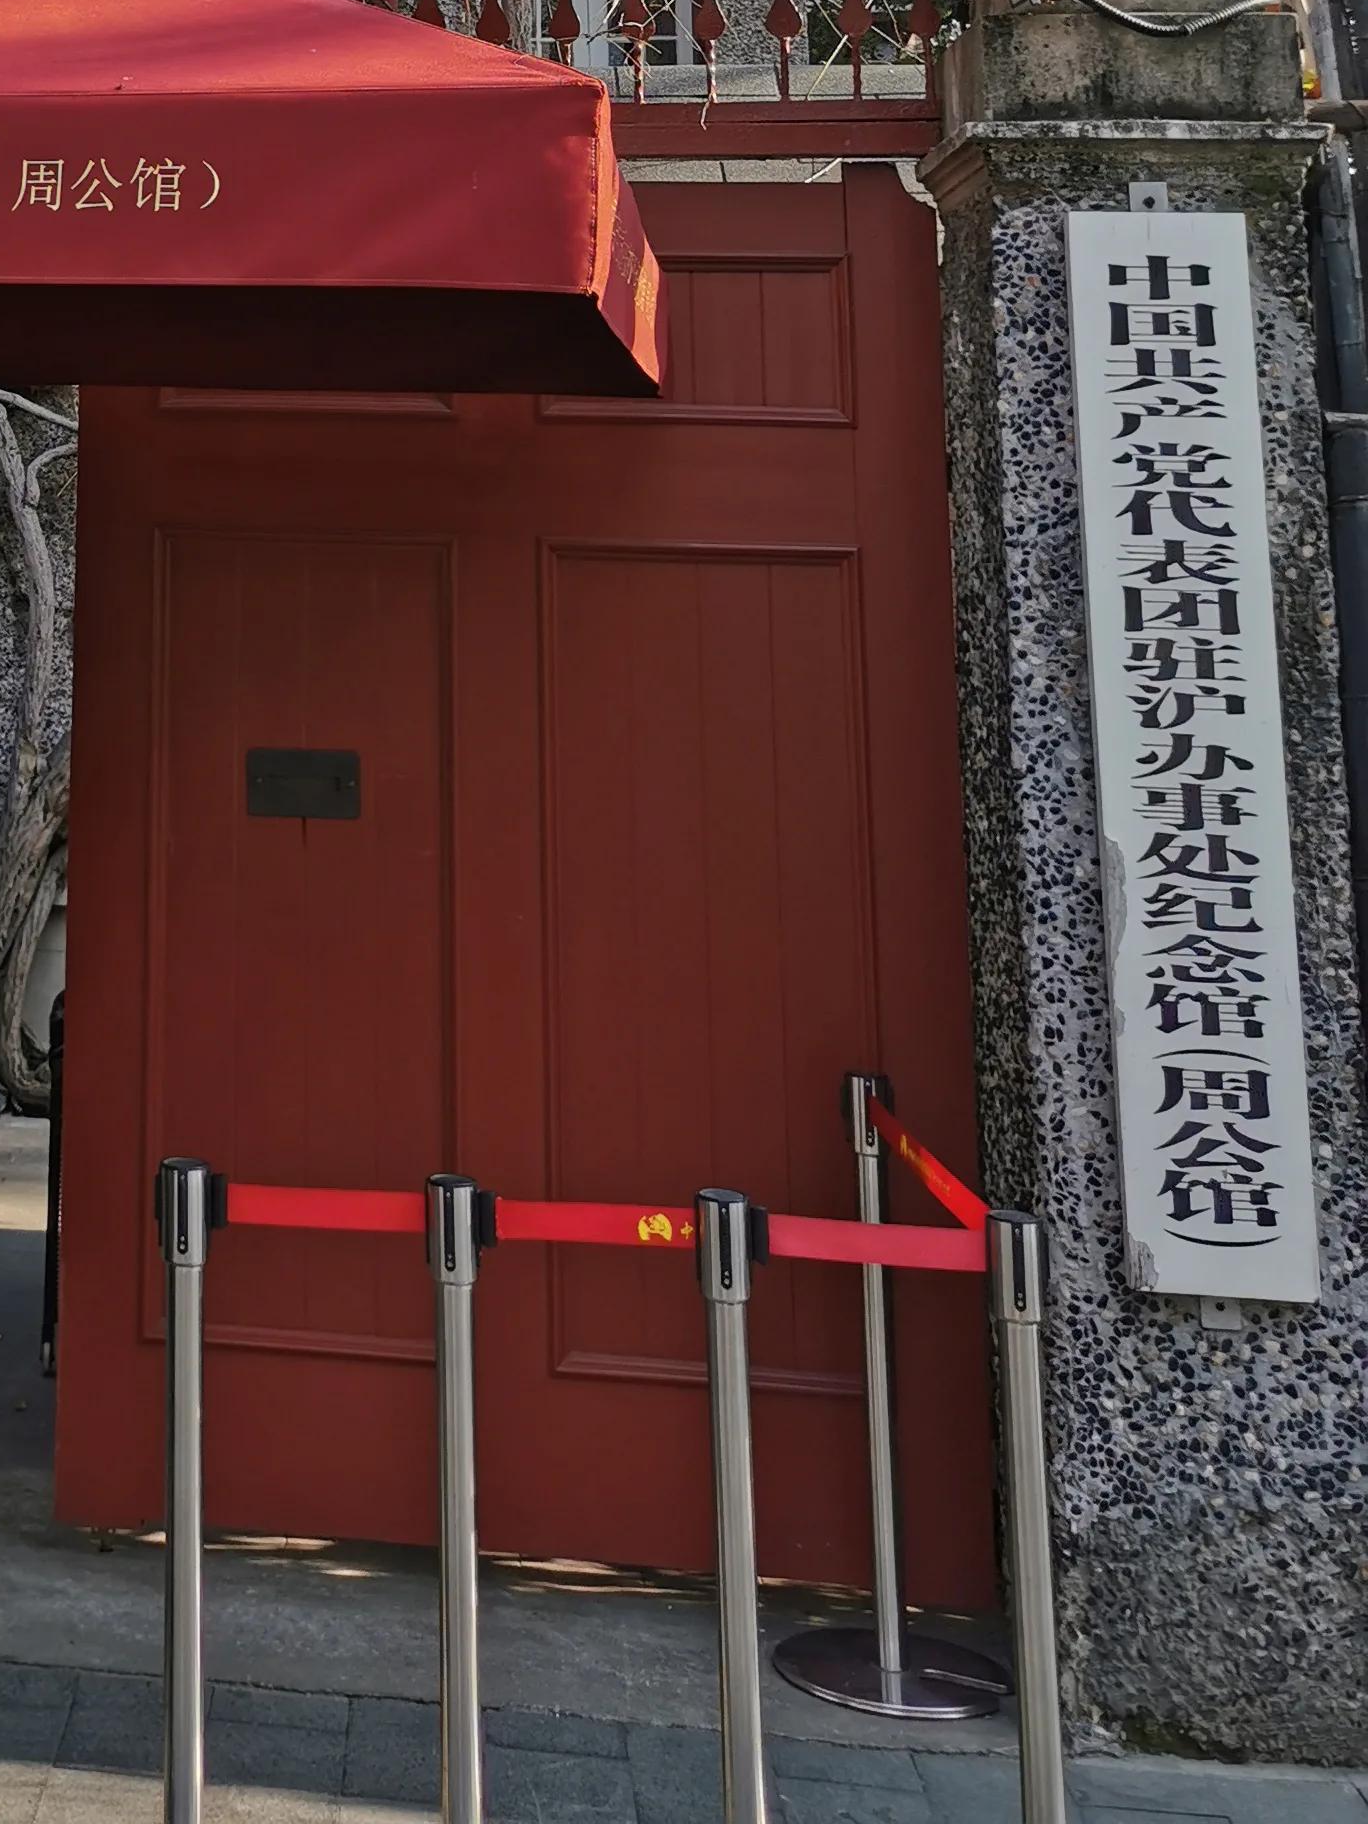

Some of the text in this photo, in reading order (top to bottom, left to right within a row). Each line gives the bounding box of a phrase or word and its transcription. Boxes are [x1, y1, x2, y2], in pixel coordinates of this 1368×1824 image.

[1104, 255, 1285, 1248] 中国共产党代表团驻沪办事处纪念馆（周公馆）
